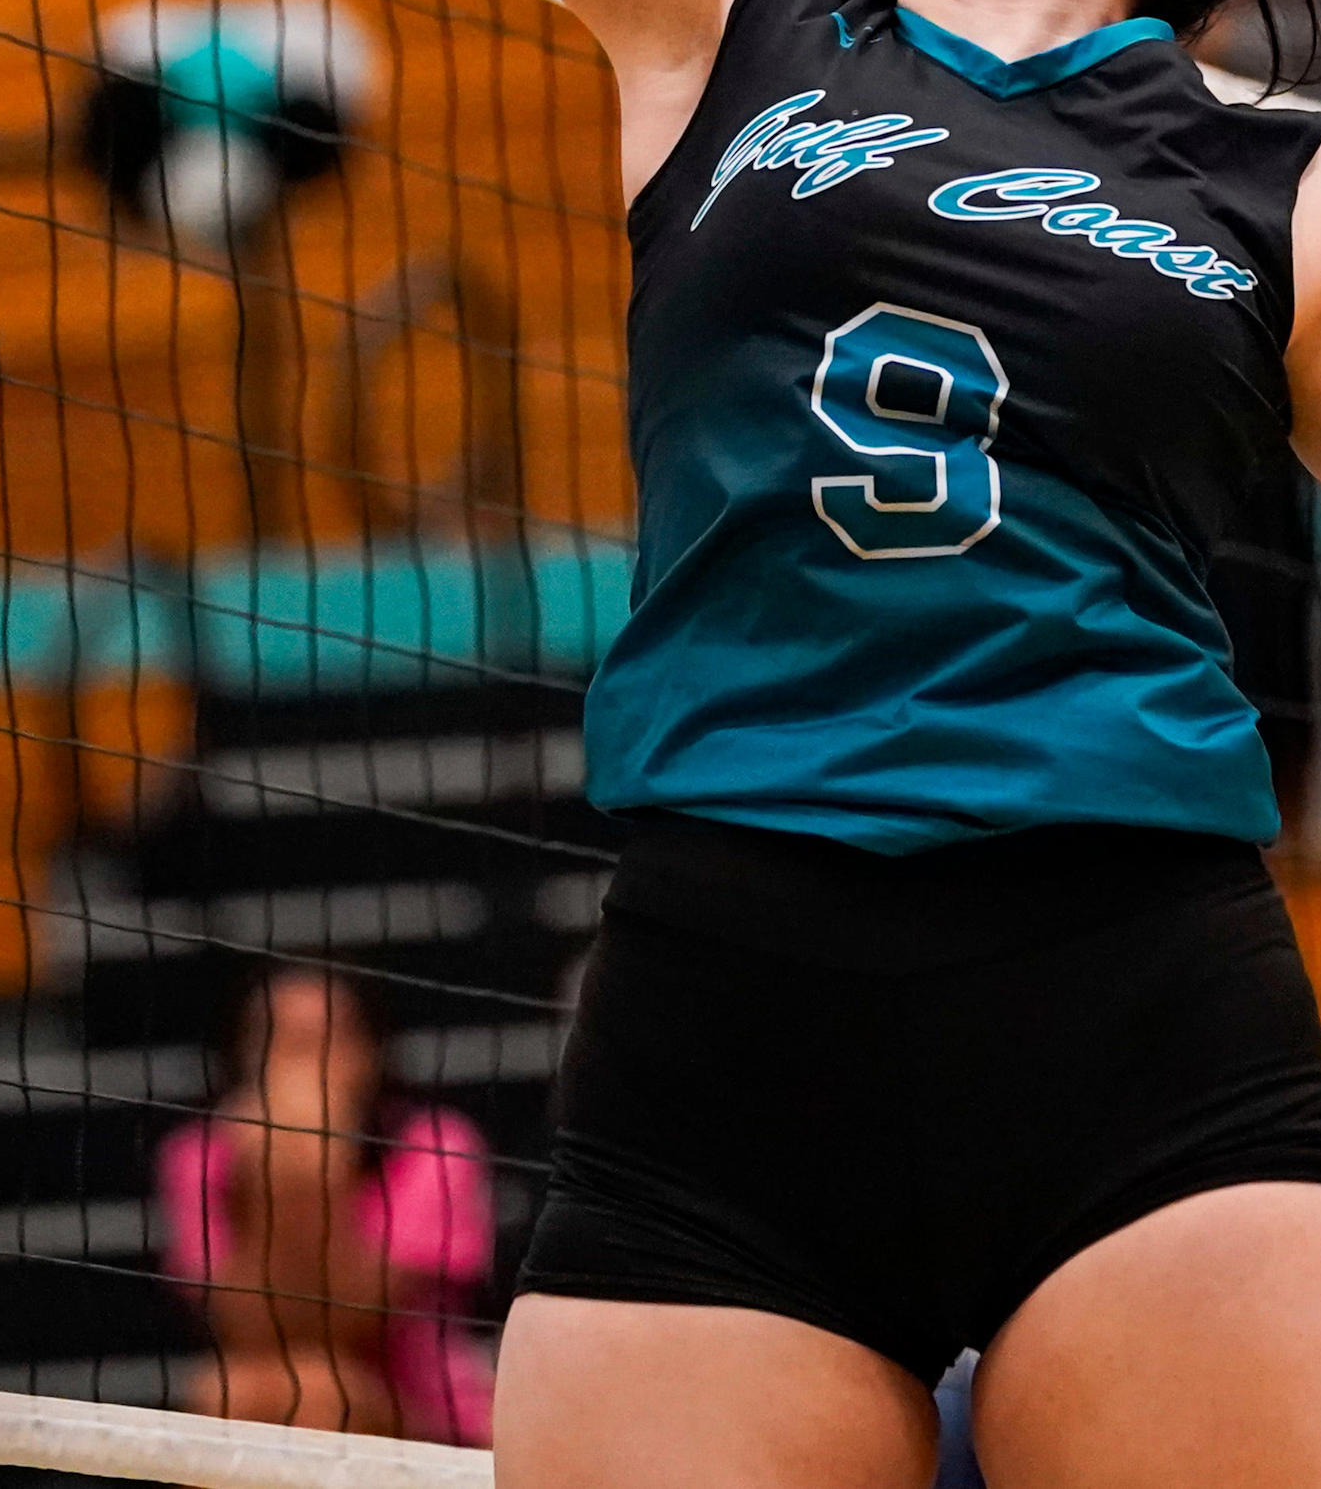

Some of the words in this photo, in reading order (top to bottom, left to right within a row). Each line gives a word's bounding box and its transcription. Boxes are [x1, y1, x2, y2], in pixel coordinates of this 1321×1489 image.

[690, 88, 950, 233] Gulf
[927, 167, 1258, 300] Coast
[811, 301, 1011, 561] 9
